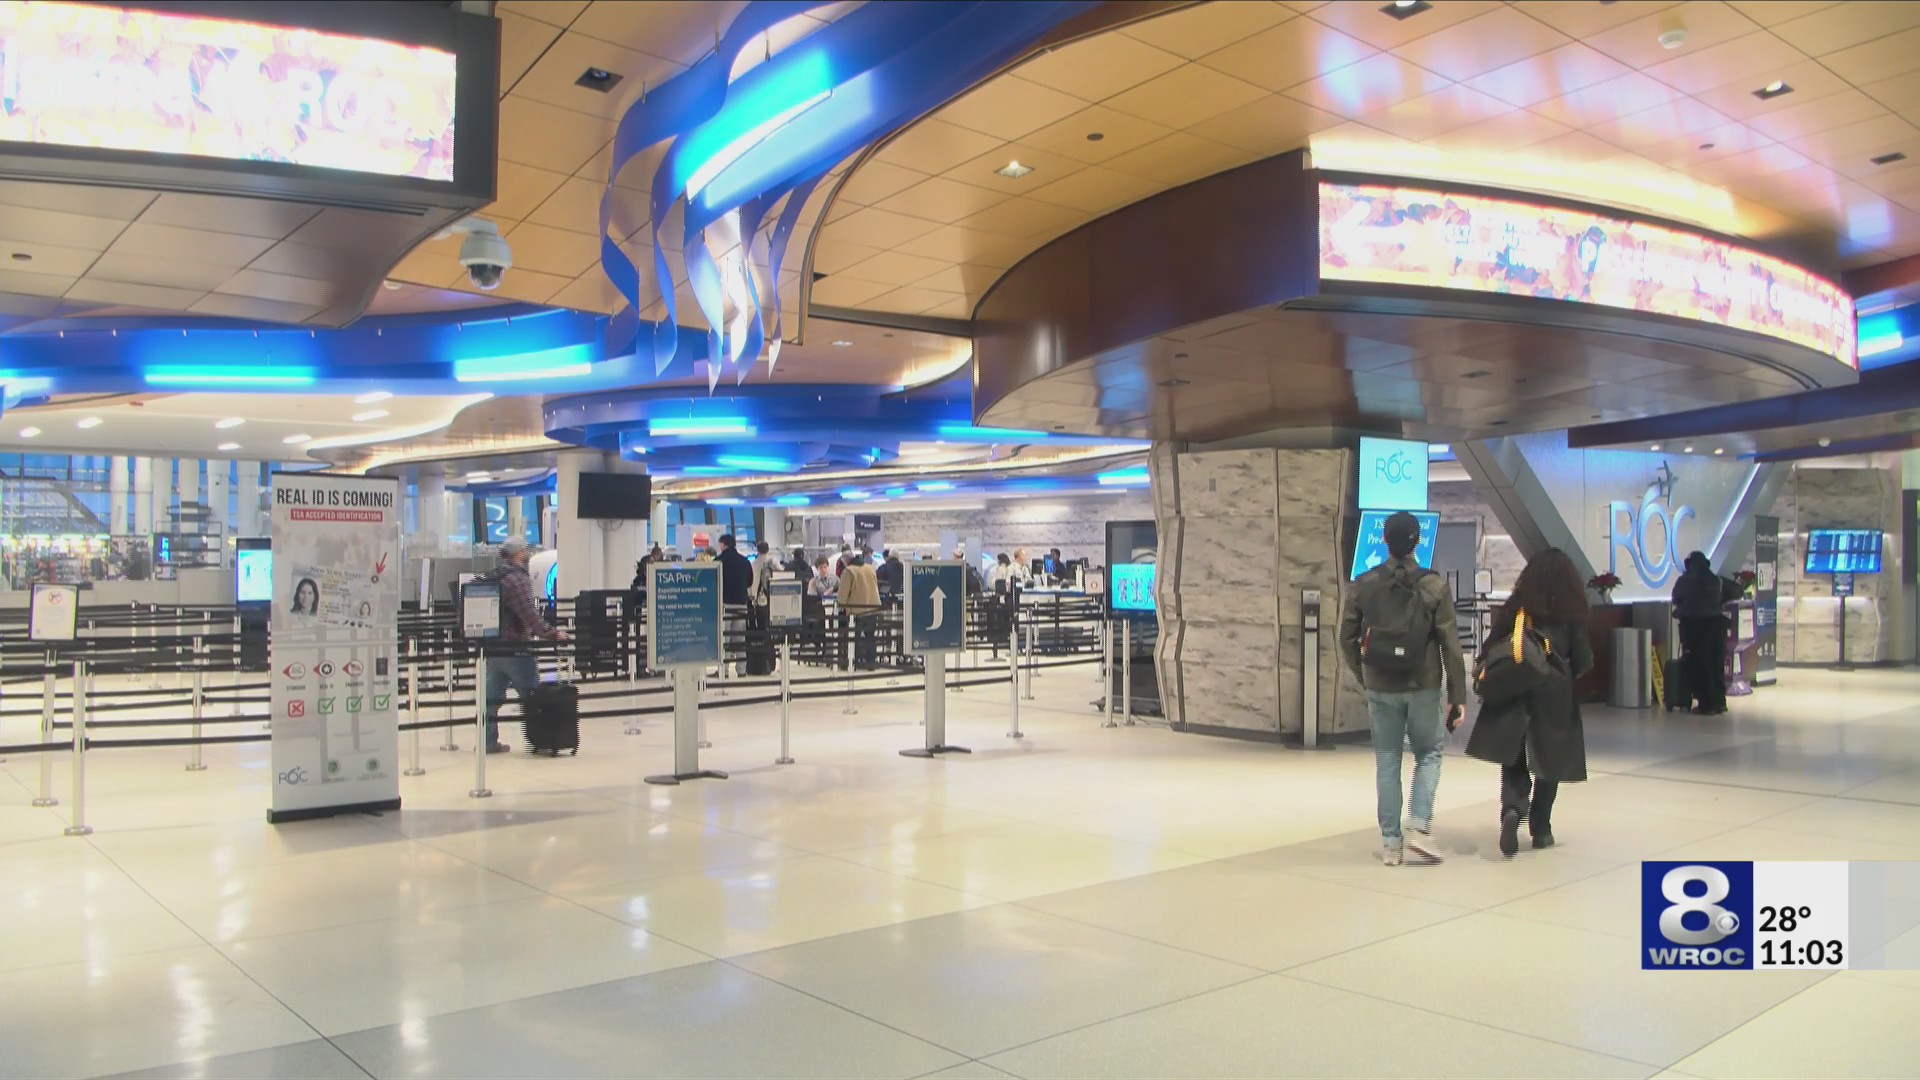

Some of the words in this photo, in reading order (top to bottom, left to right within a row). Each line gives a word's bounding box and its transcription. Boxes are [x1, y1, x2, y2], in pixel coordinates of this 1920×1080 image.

[1375, 450, 1413, 484] ROC
[276, 488, 308, 505] REAL
[312, 489, 325, 505] ID
[328, 490, 340, 506] IS
[343, 491, 393, 508] COMING!
[293, 510, 304, 519] TSA
[306, 510, 336, 520] ACCEPTED
[336, 511, 381, 521] IDENTIFICATION
[1609, 478, 1696, 590] ROC
[657, 573, 675, 583] TSA
[676, 572, 692, 583] Pre
[913, 567, 925, 575] TSA
[278, 767, 308, 785] ROC
